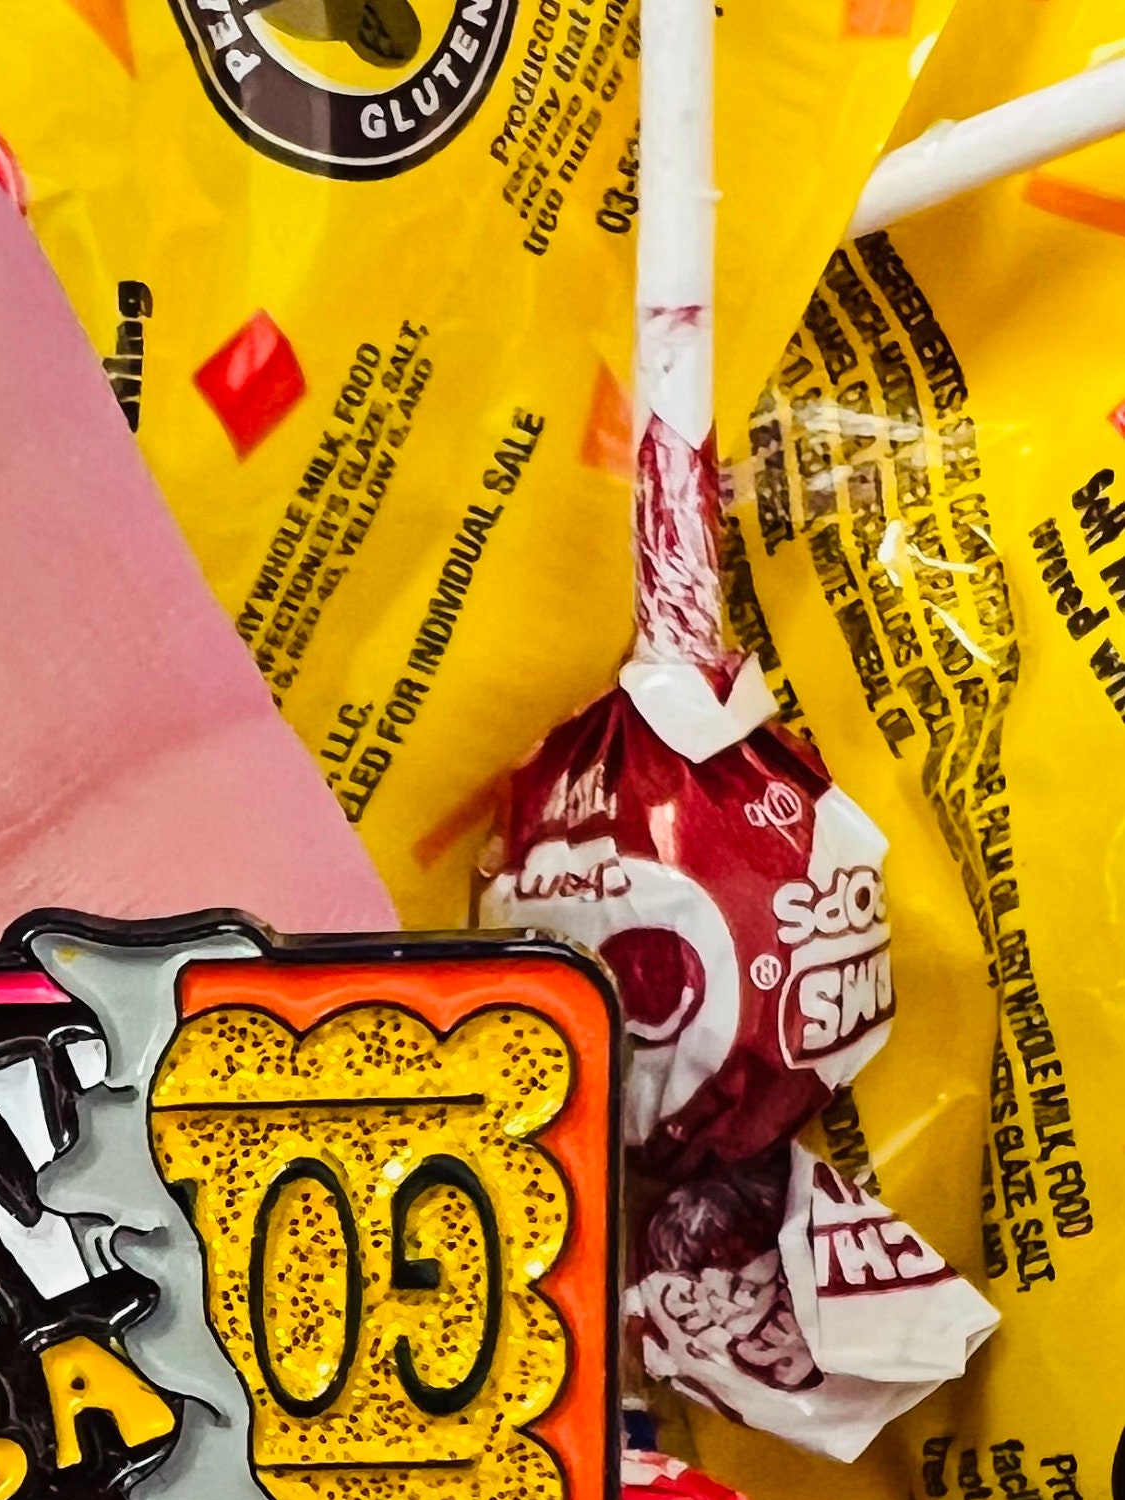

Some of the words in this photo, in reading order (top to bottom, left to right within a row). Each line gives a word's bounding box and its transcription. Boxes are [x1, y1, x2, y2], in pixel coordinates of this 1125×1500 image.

[333, 342, 381, 425] FOOD
[377, 677, 431, 746] FOR
[407, 504, 505, 677] INDIVIDUAL
[482, 406, 546, 496] SALE
[1044, 1159, 1095, 1240] FOOD
